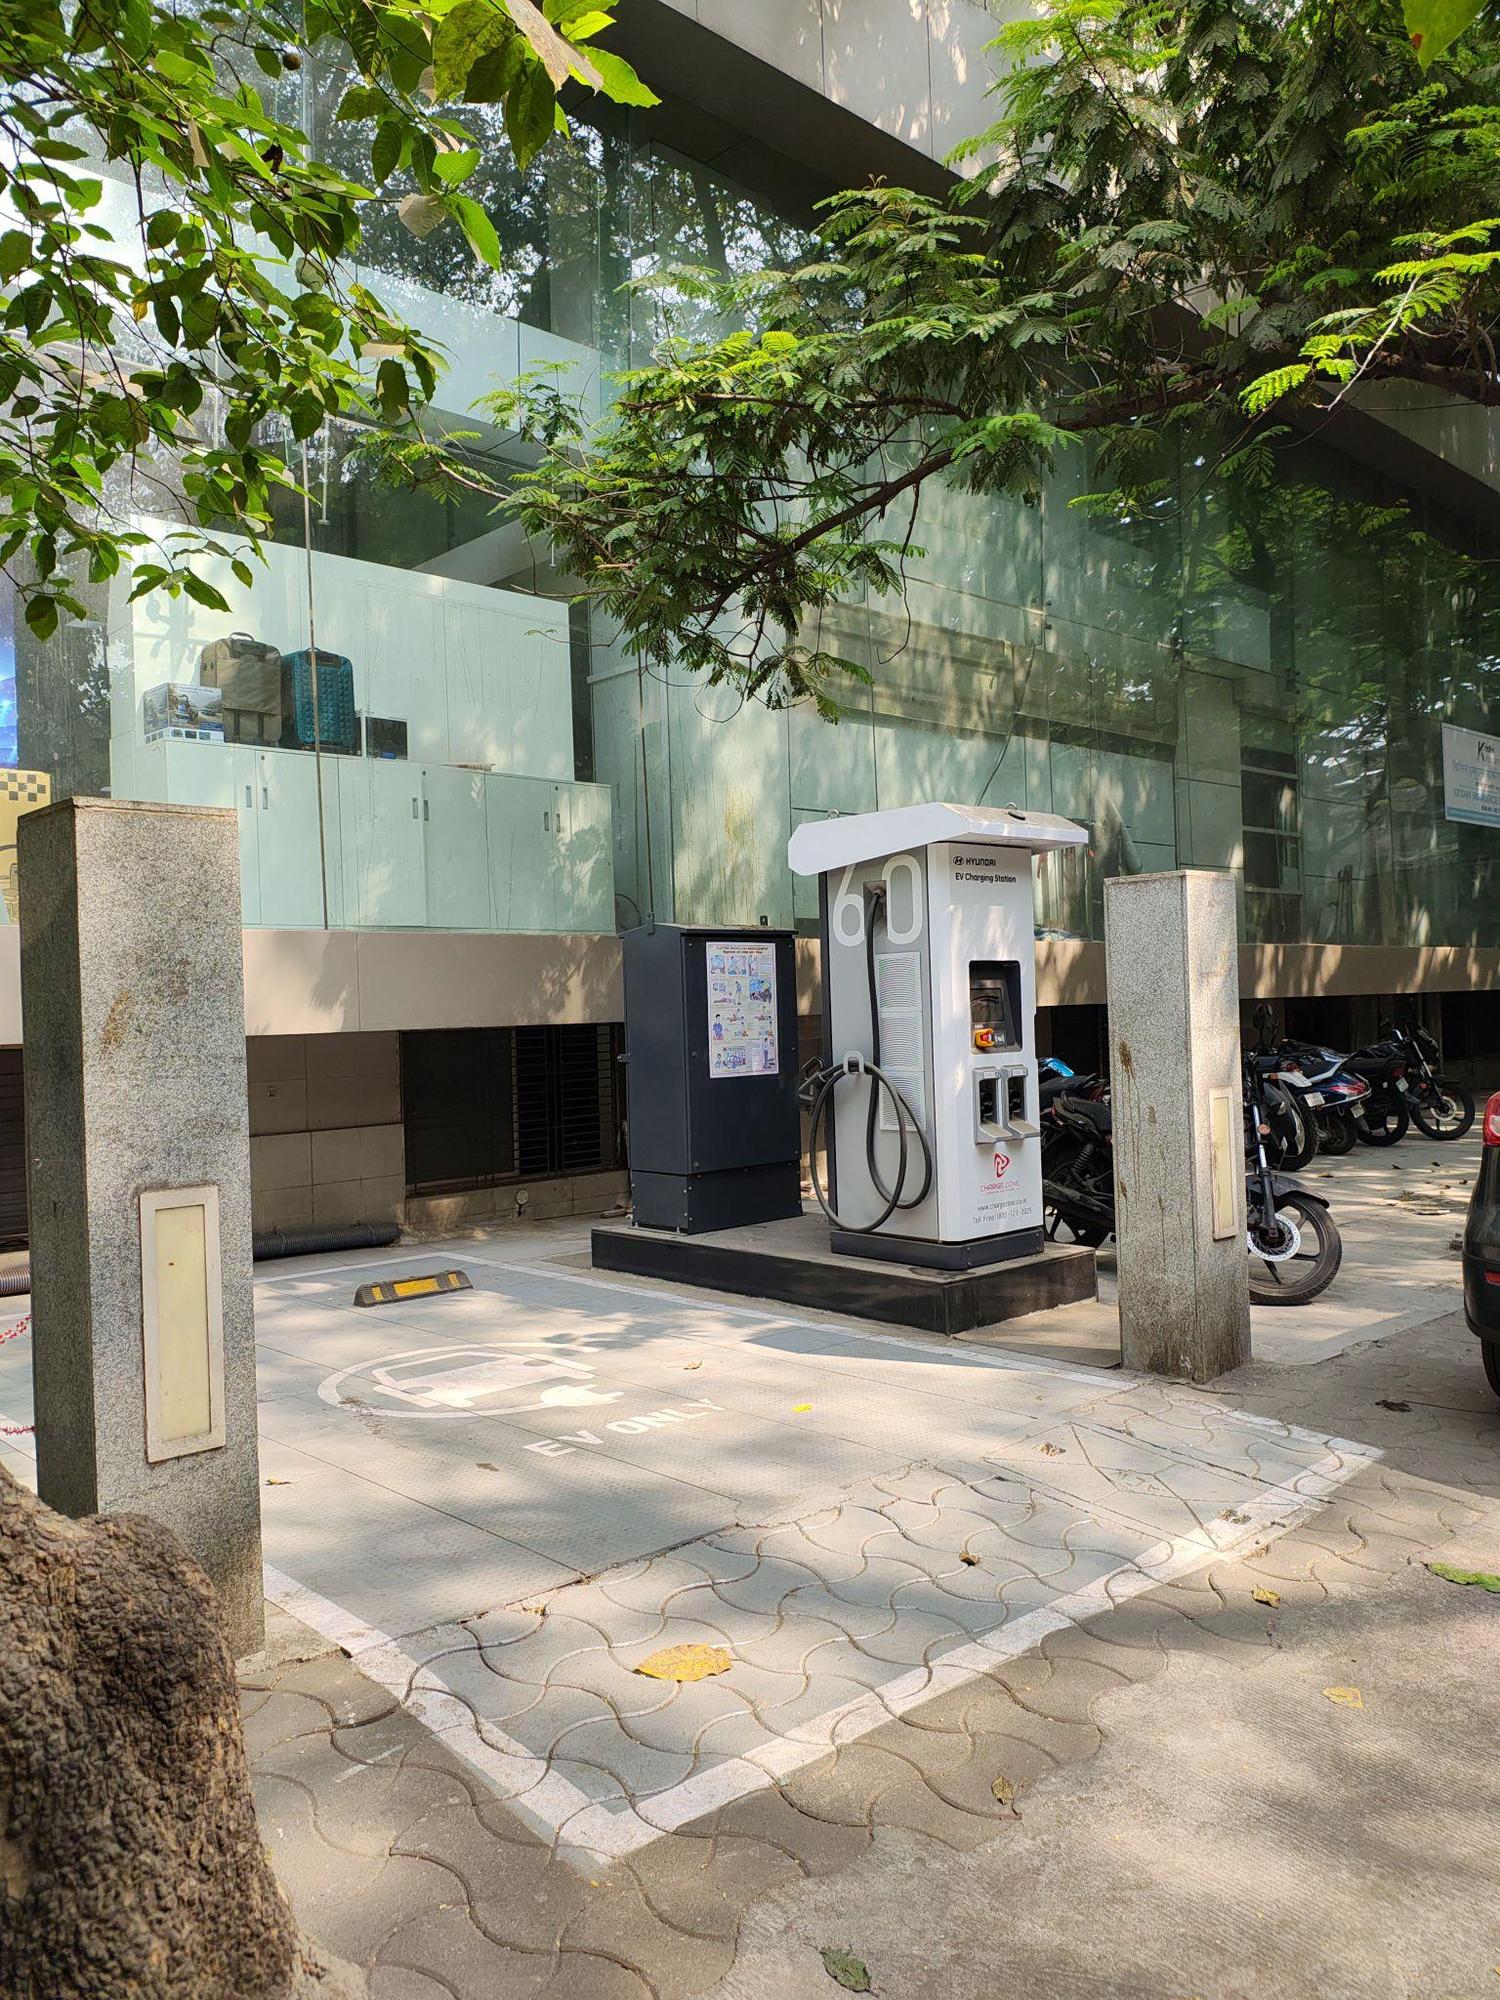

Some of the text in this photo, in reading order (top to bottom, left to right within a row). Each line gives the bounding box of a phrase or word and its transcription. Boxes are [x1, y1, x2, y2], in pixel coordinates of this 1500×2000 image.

[955, 872, 1017, 884] EV Charging Station
[965, 857, 997, 867] HYUNDAI
[832, 852, 923, 947] 60
[523, 1398, 726, 1458] EV ONLY
